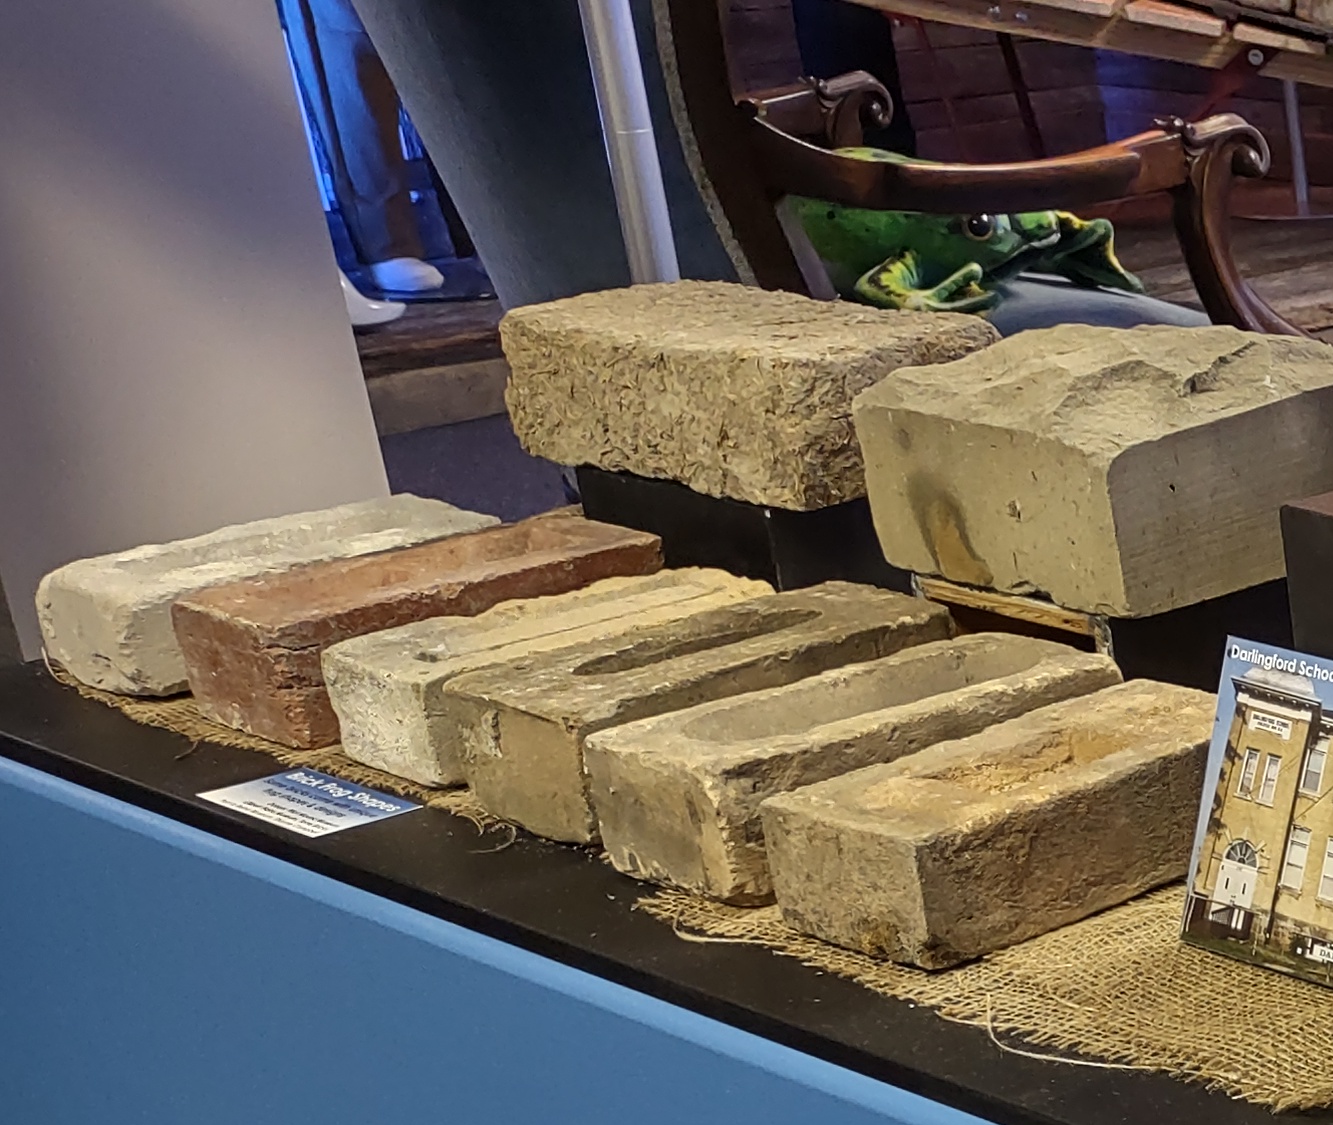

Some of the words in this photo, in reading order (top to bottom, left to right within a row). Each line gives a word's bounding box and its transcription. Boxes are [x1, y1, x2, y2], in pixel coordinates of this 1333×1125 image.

[1231, 645, 1297, 674] Darlingford
[285, 771, 325, 787] Brick
[348, 792, 400, 812] Shapes
